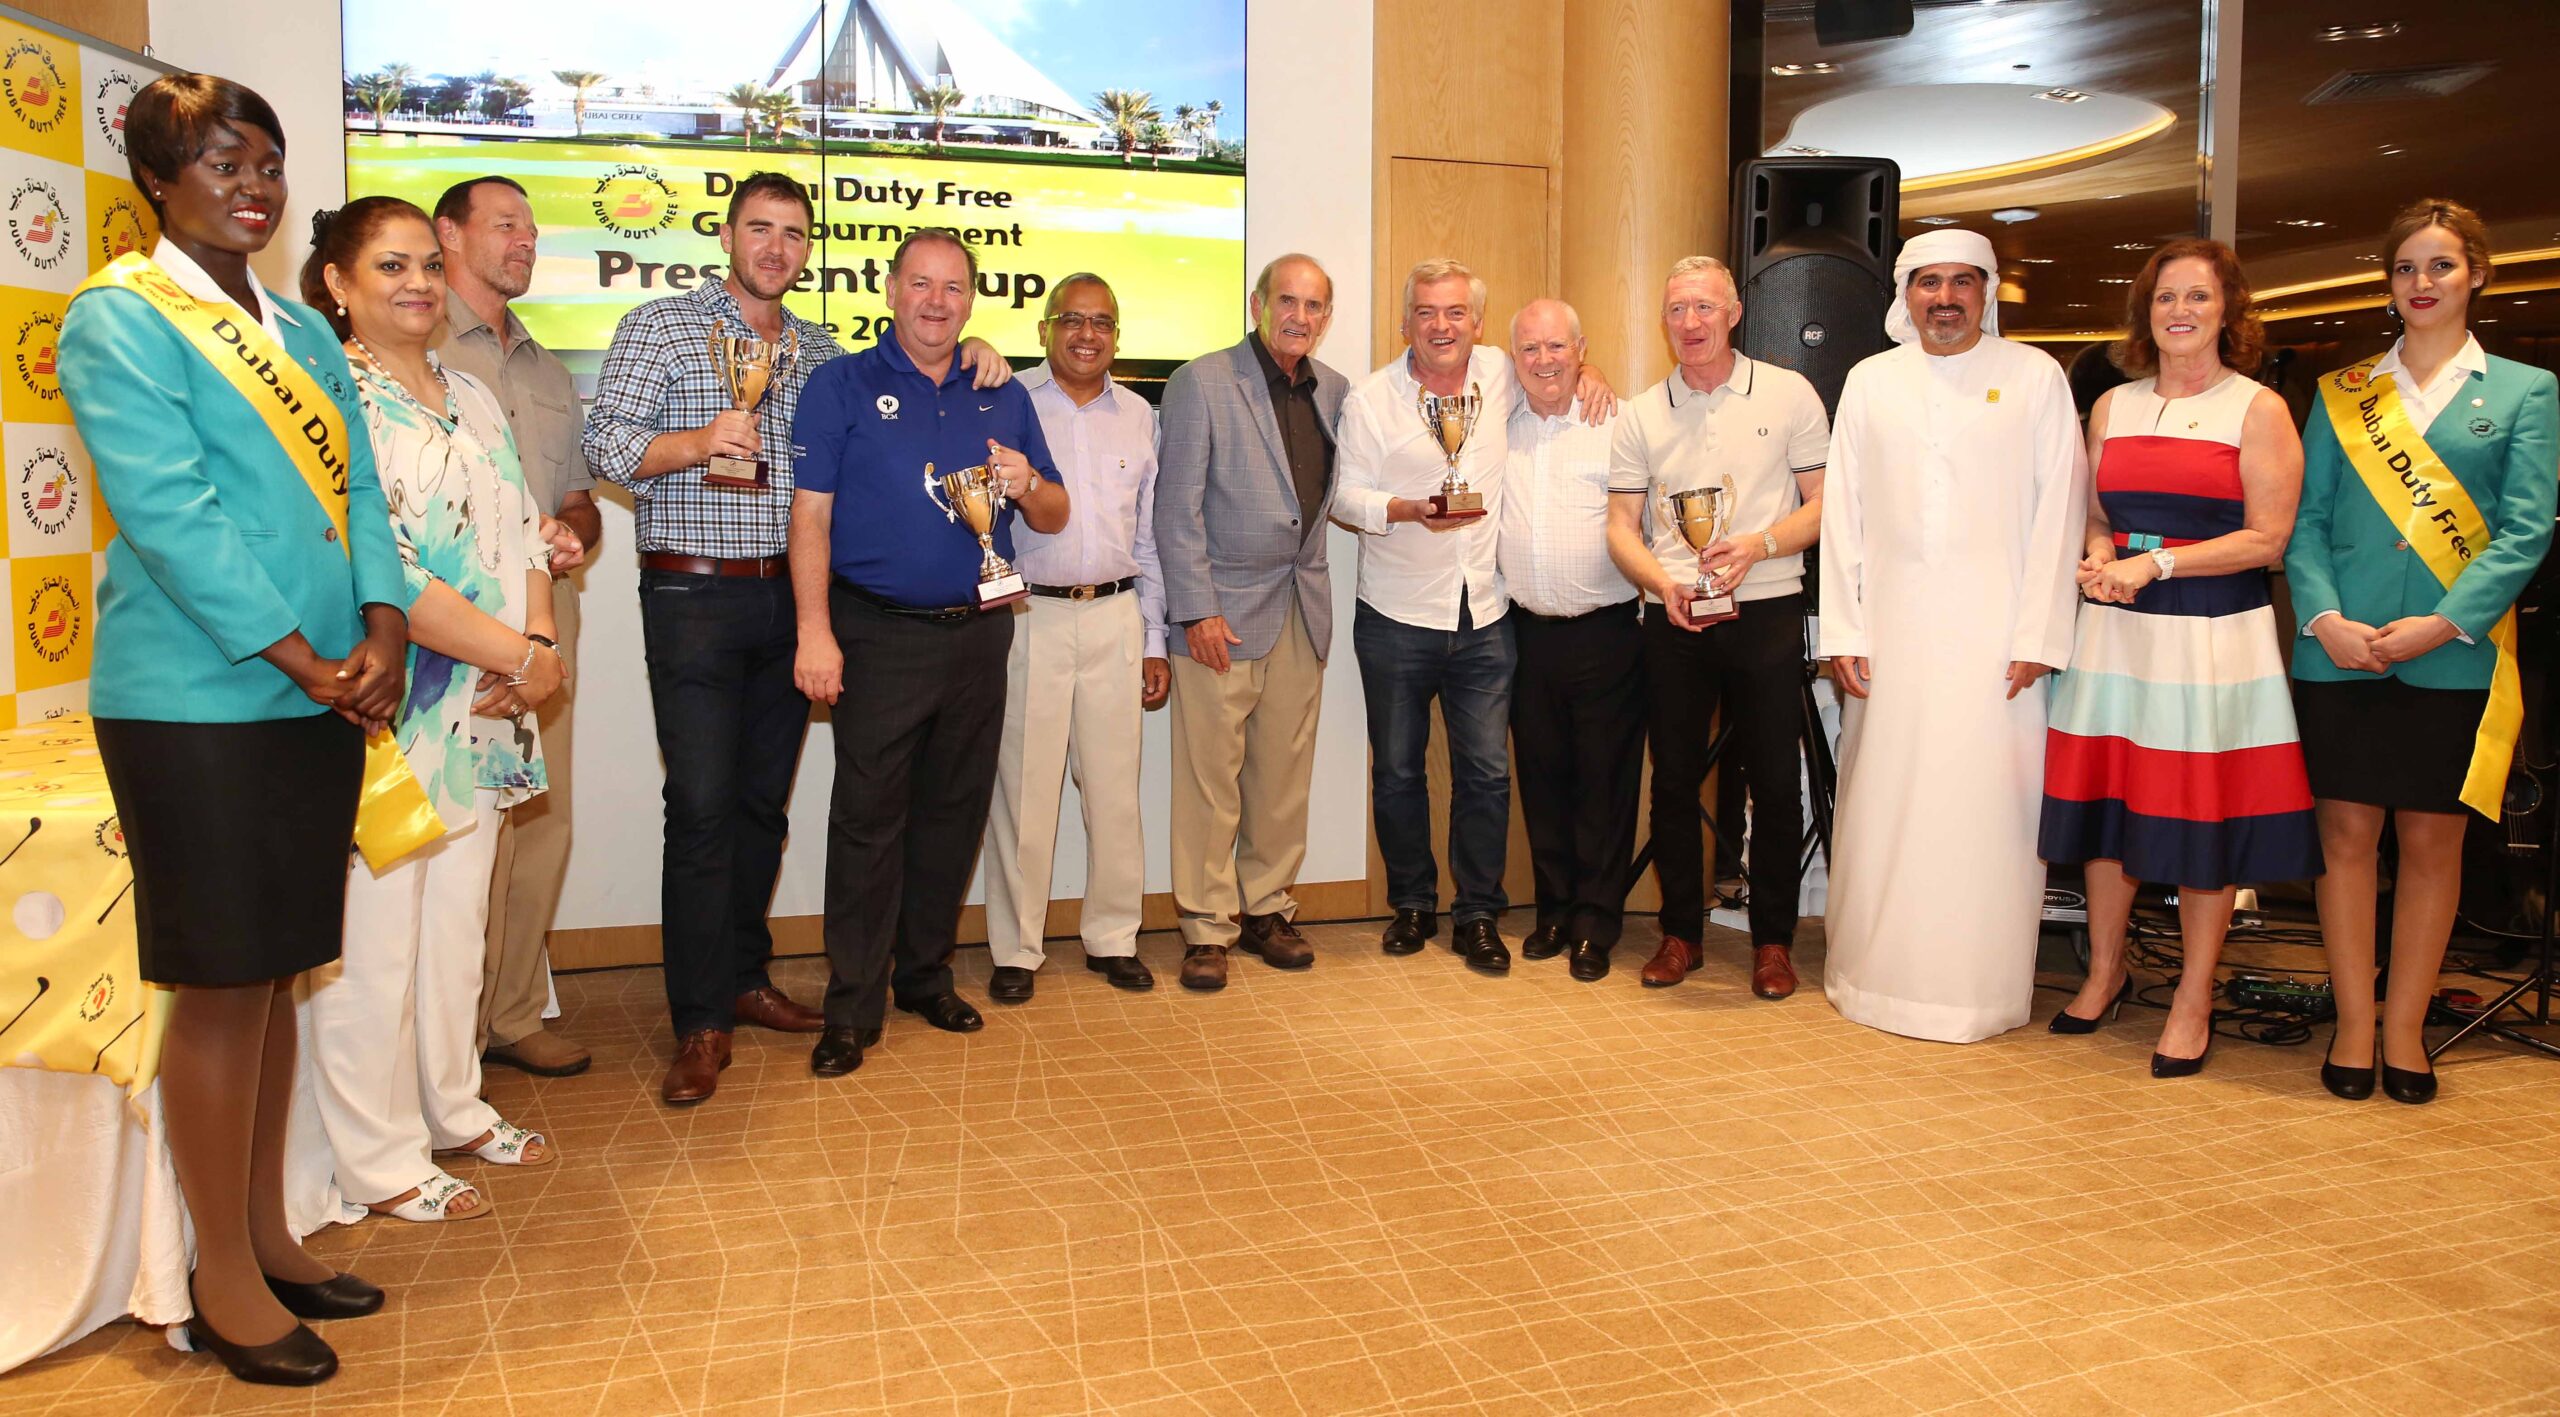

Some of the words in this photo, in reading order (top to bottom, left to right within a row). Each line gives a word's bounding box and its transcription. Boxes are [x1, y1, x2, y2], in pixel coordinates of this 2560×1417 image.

[3, 78, 26, 122] DUBAI
[29, 118, 54, 133] DUTY
[54, 95, 67, 125] FREE
[611, 113, 643, 121] CREEK
[97, 107, 117, 147] DUBAI
[118, 143, 128, 156] DU
[833, 177, 924, 210] Duty
[935, 181, 1013, 208] Free
[592, 201, 620, 234] DUBAI
[623, 226, 658, 240] DUTY
[659, 203, 678, 229] FREE
[811, 222, 1023, 246] ournent
[9, 219, 32, 261] DUBAI
[34, 256, 58, 270] DUTY
[58, 230, 71, 260] FREE
[102, 236, 113, 262] DUB
[974, 271, 1046, 309] up
[851, 316, 891, 340] 20
[1804, 330, 1824, 341] RCF
[16, 354, 39, 394] DUBAI
[211, 317, 303, 416] Dubai
[302, 413, 348, 496] Duty
[2359, 393, 2392, 453] Dubai
[2387, 449, 2437, 508] Duty
[2431, 508, 2472, 562] Free
[22, 491, 42, 530] DUBAI
[44, 518, 66, 534] DUTY
[66, 490, 78, 520] FREE
[28, 622, 47, 659] DUBAI
[49, 645, 69, 662] DUTY
[70, 616, 80, 646] FREE
